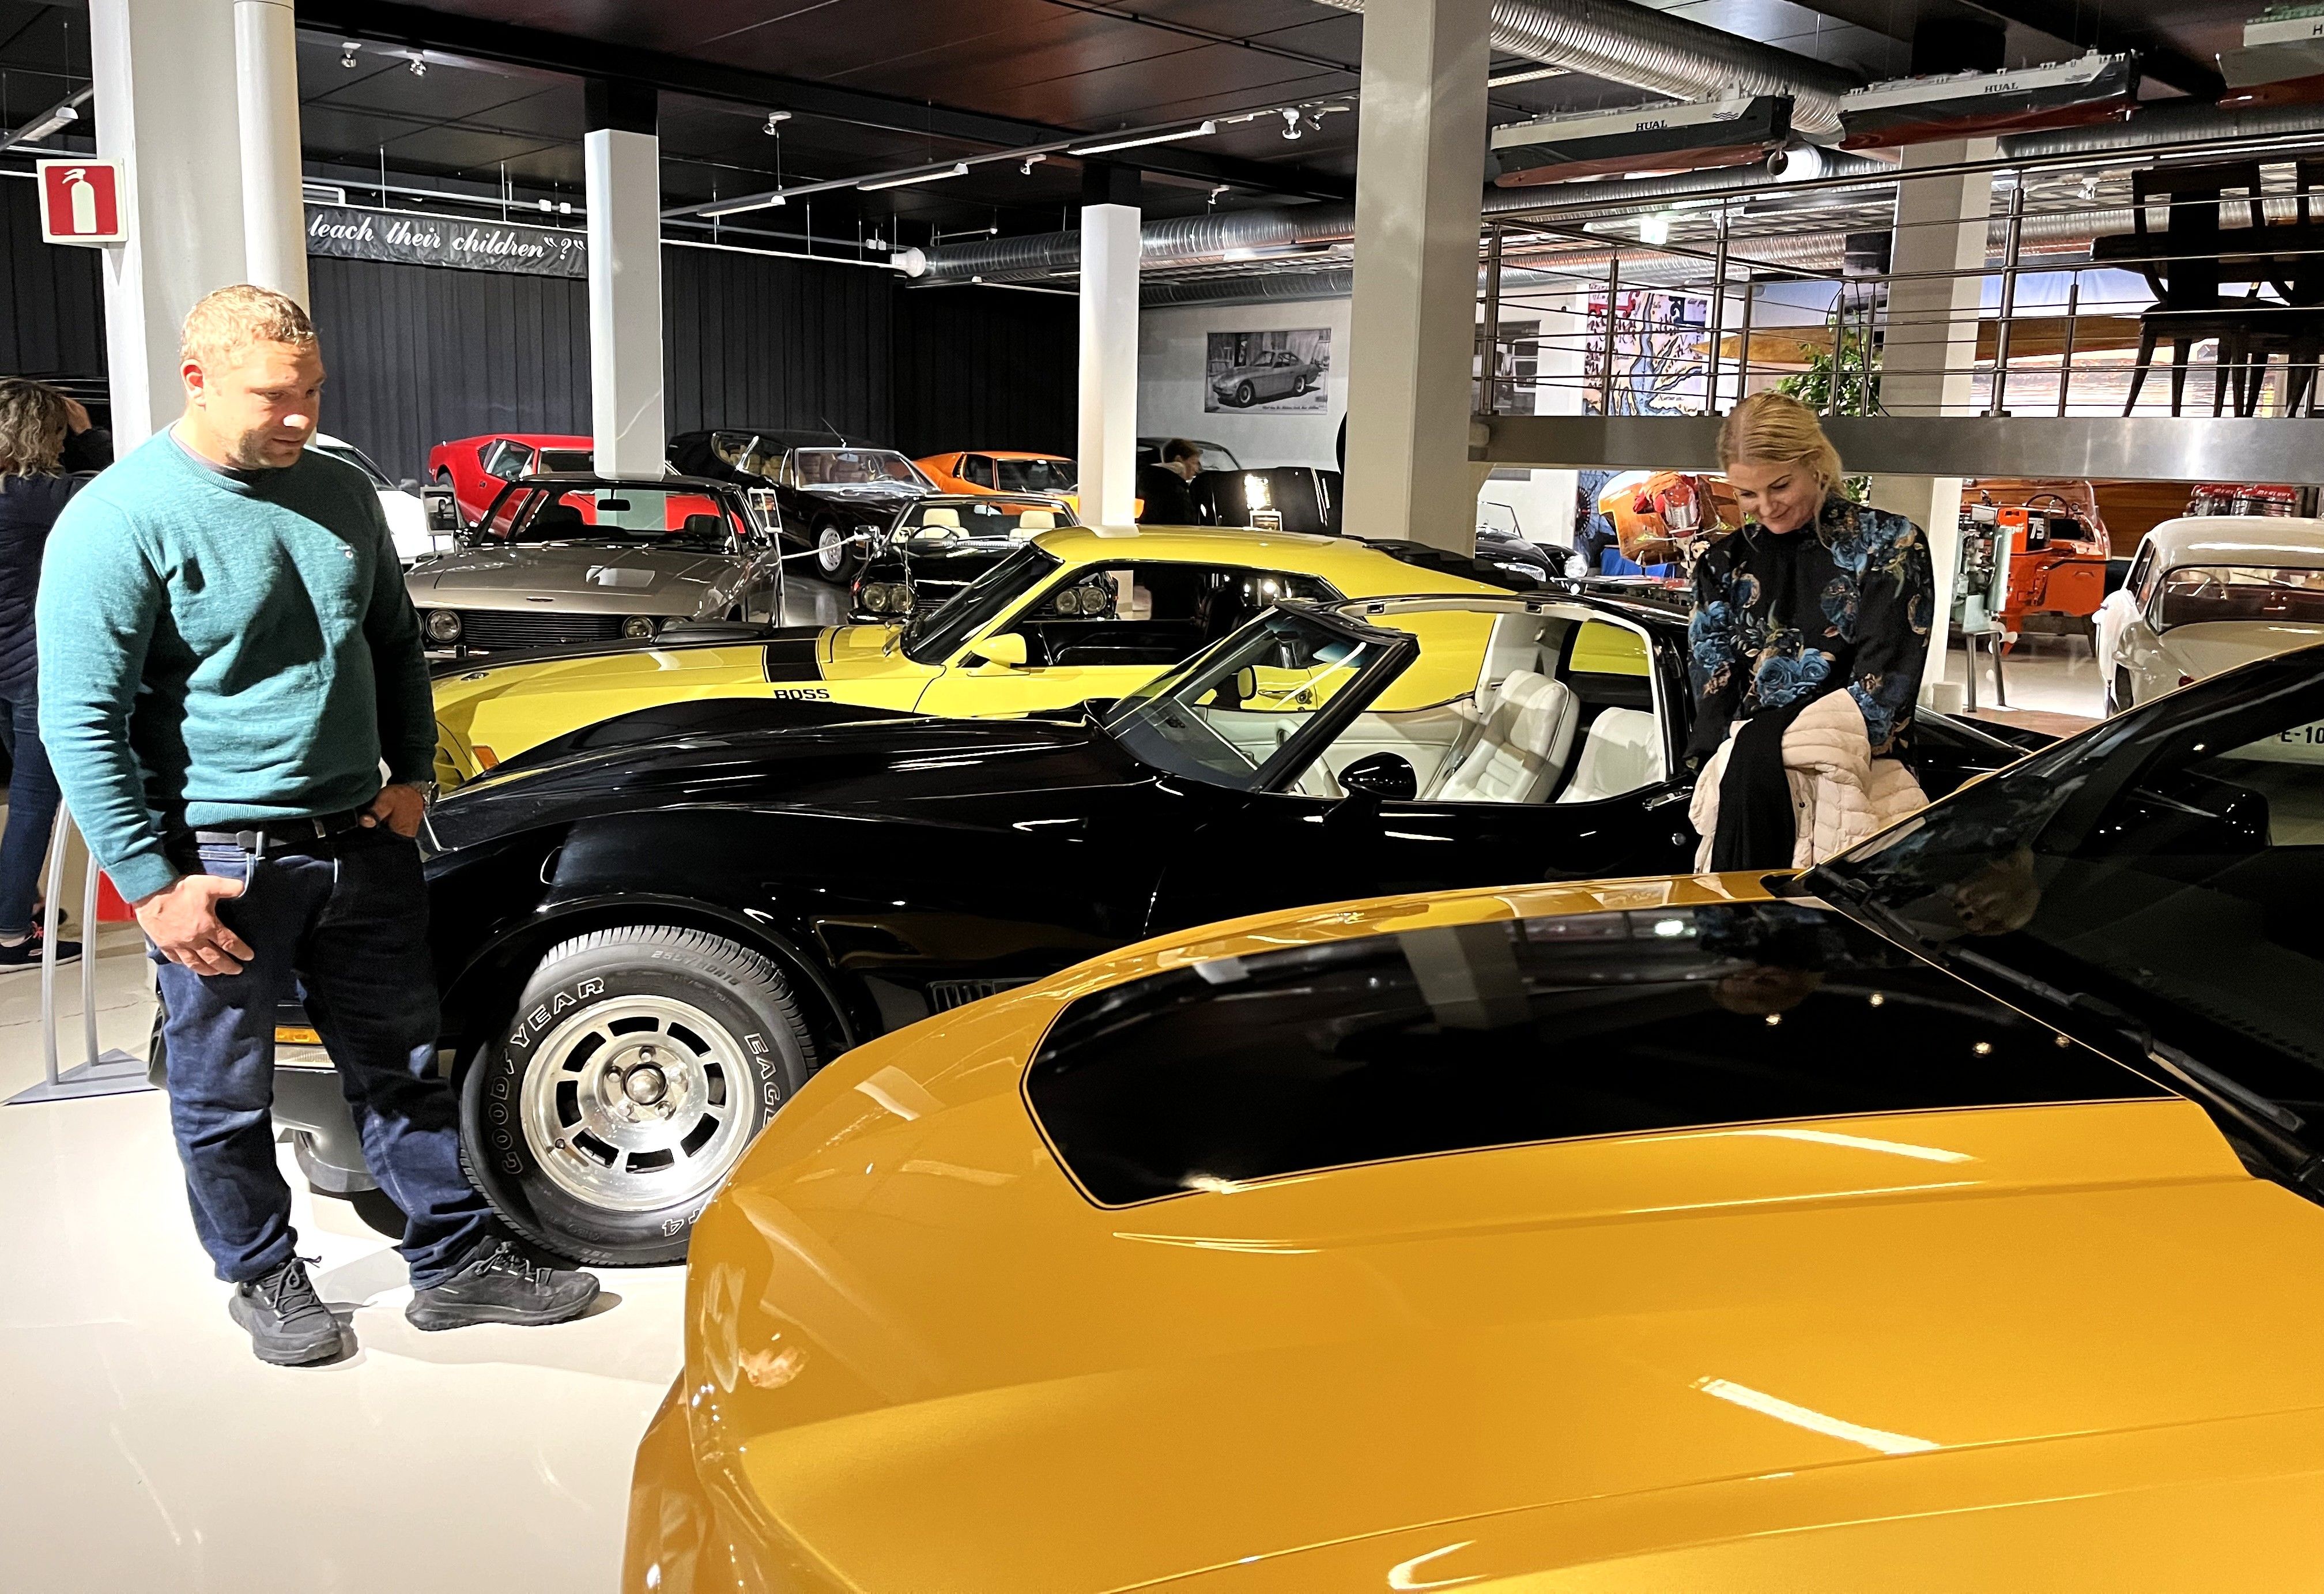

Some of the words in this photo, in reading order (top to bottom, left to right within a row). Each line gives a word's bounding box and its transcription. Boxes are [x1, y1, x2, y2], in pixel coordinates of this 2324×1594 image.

[1985, 82, 2019, 93] HUAL
[1636, 120, 1667, 131] HUAL
[385, 221, 441, 248] their
[2028, 518, 2044, 539] 75
[774, 689, 830, 699] BOSS
